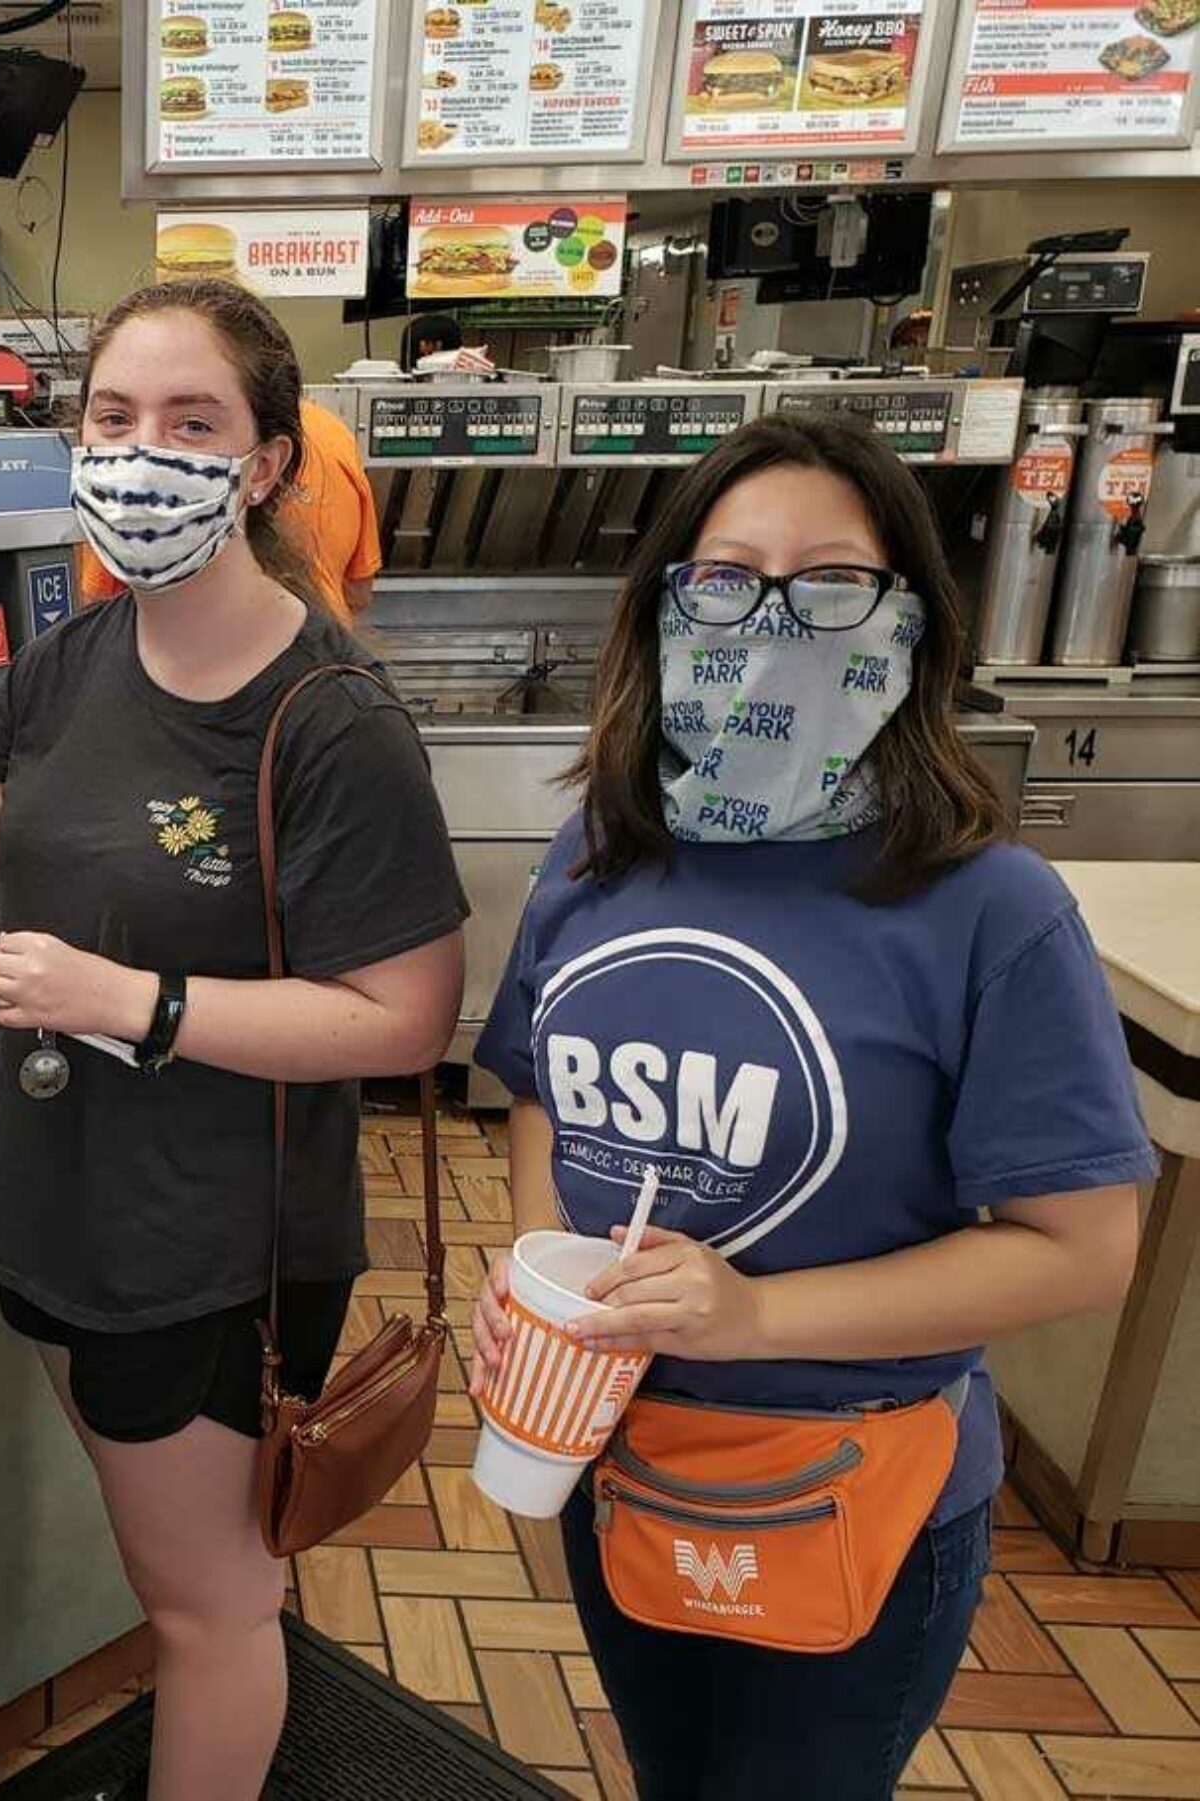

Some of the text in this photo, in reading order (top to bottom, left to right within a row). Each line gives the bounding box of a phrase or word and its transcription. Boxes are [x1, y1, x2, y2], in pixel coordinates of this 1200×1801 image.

[705, 24, 748, 41] SWEET
[757, 23, 794, 40] SPICY
[818, 19, 905, 46] Honey BBQ
[415, 207, 475, 223] Add-Ons
[248, 240, 360, 266] BREAKFAST
[270, 268, 289, 277] ON
[306, 267, 336, 277] BUN
[1022, 470, 1066, 488] TEA
[37, 575, 63, 603] ICE
[740, 616, 815, 640] PARK
[705, 649, 748, 663] YOUR
[863, 656, 889, 672] YOUR
[693, 663, 747, 684] PARK
[842, 668, 888, 693] PARK
[670, 701, 703, 715] YOUR
[749, 702, 796, 720] YOUR
[664, 714, 709, 734] PARK
[723, 716, 793, 740] PARK
[1065, 728, 1097, 767] 14
[721, 796, 770, 819] YOUR
[698, 807, 768, 836] PARK
[547, 1034, 780, 1168] BSM
[682, 1597, 767, 1617] WHATABURGER
